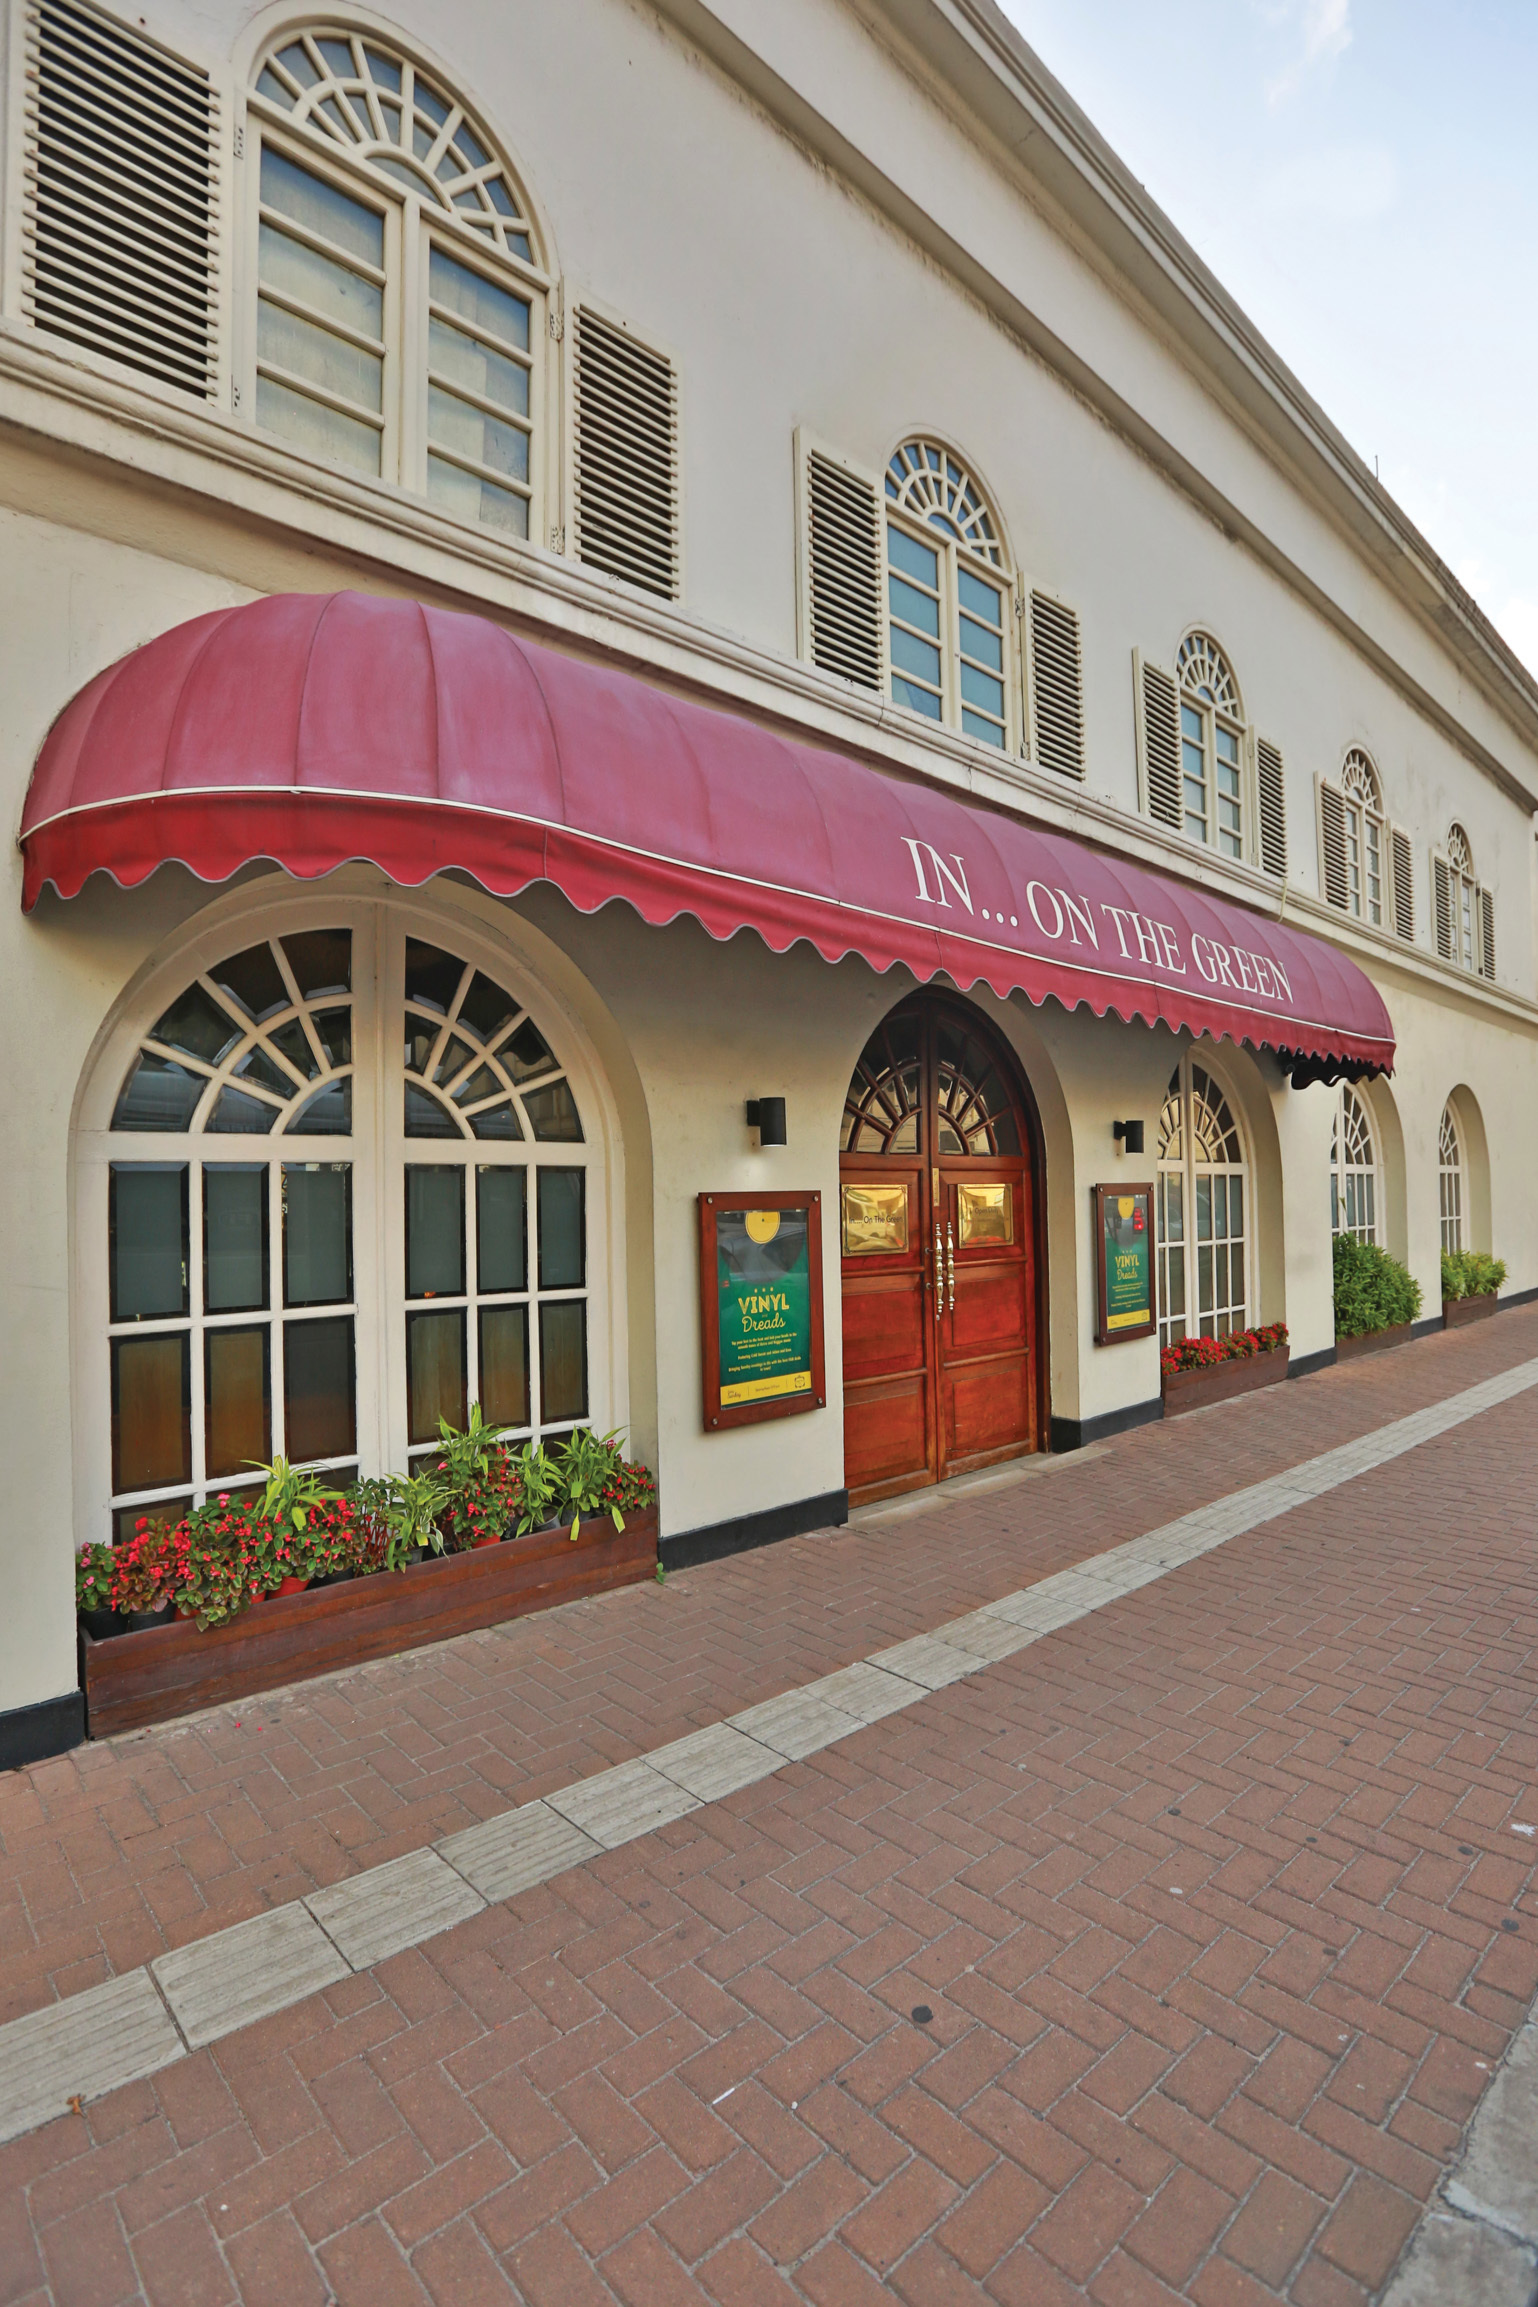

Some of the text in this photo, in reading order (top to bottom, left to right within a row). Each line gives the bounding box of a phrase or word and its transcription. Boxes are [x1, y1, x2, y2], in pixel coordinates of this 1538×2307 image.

[900, 836, 1294, 1004] IN... ON THE GREEN
[864, 1215, 873, 1224] On
[874, 1215, 885, 1223] The
[1115, 1254, 1139, 1268] VINYL
[1117, 1267, 1138, 1280] Dreads
[738, 1293, 790, 1315] VINYL
[742, 1312, 786, 1332] Dreads
